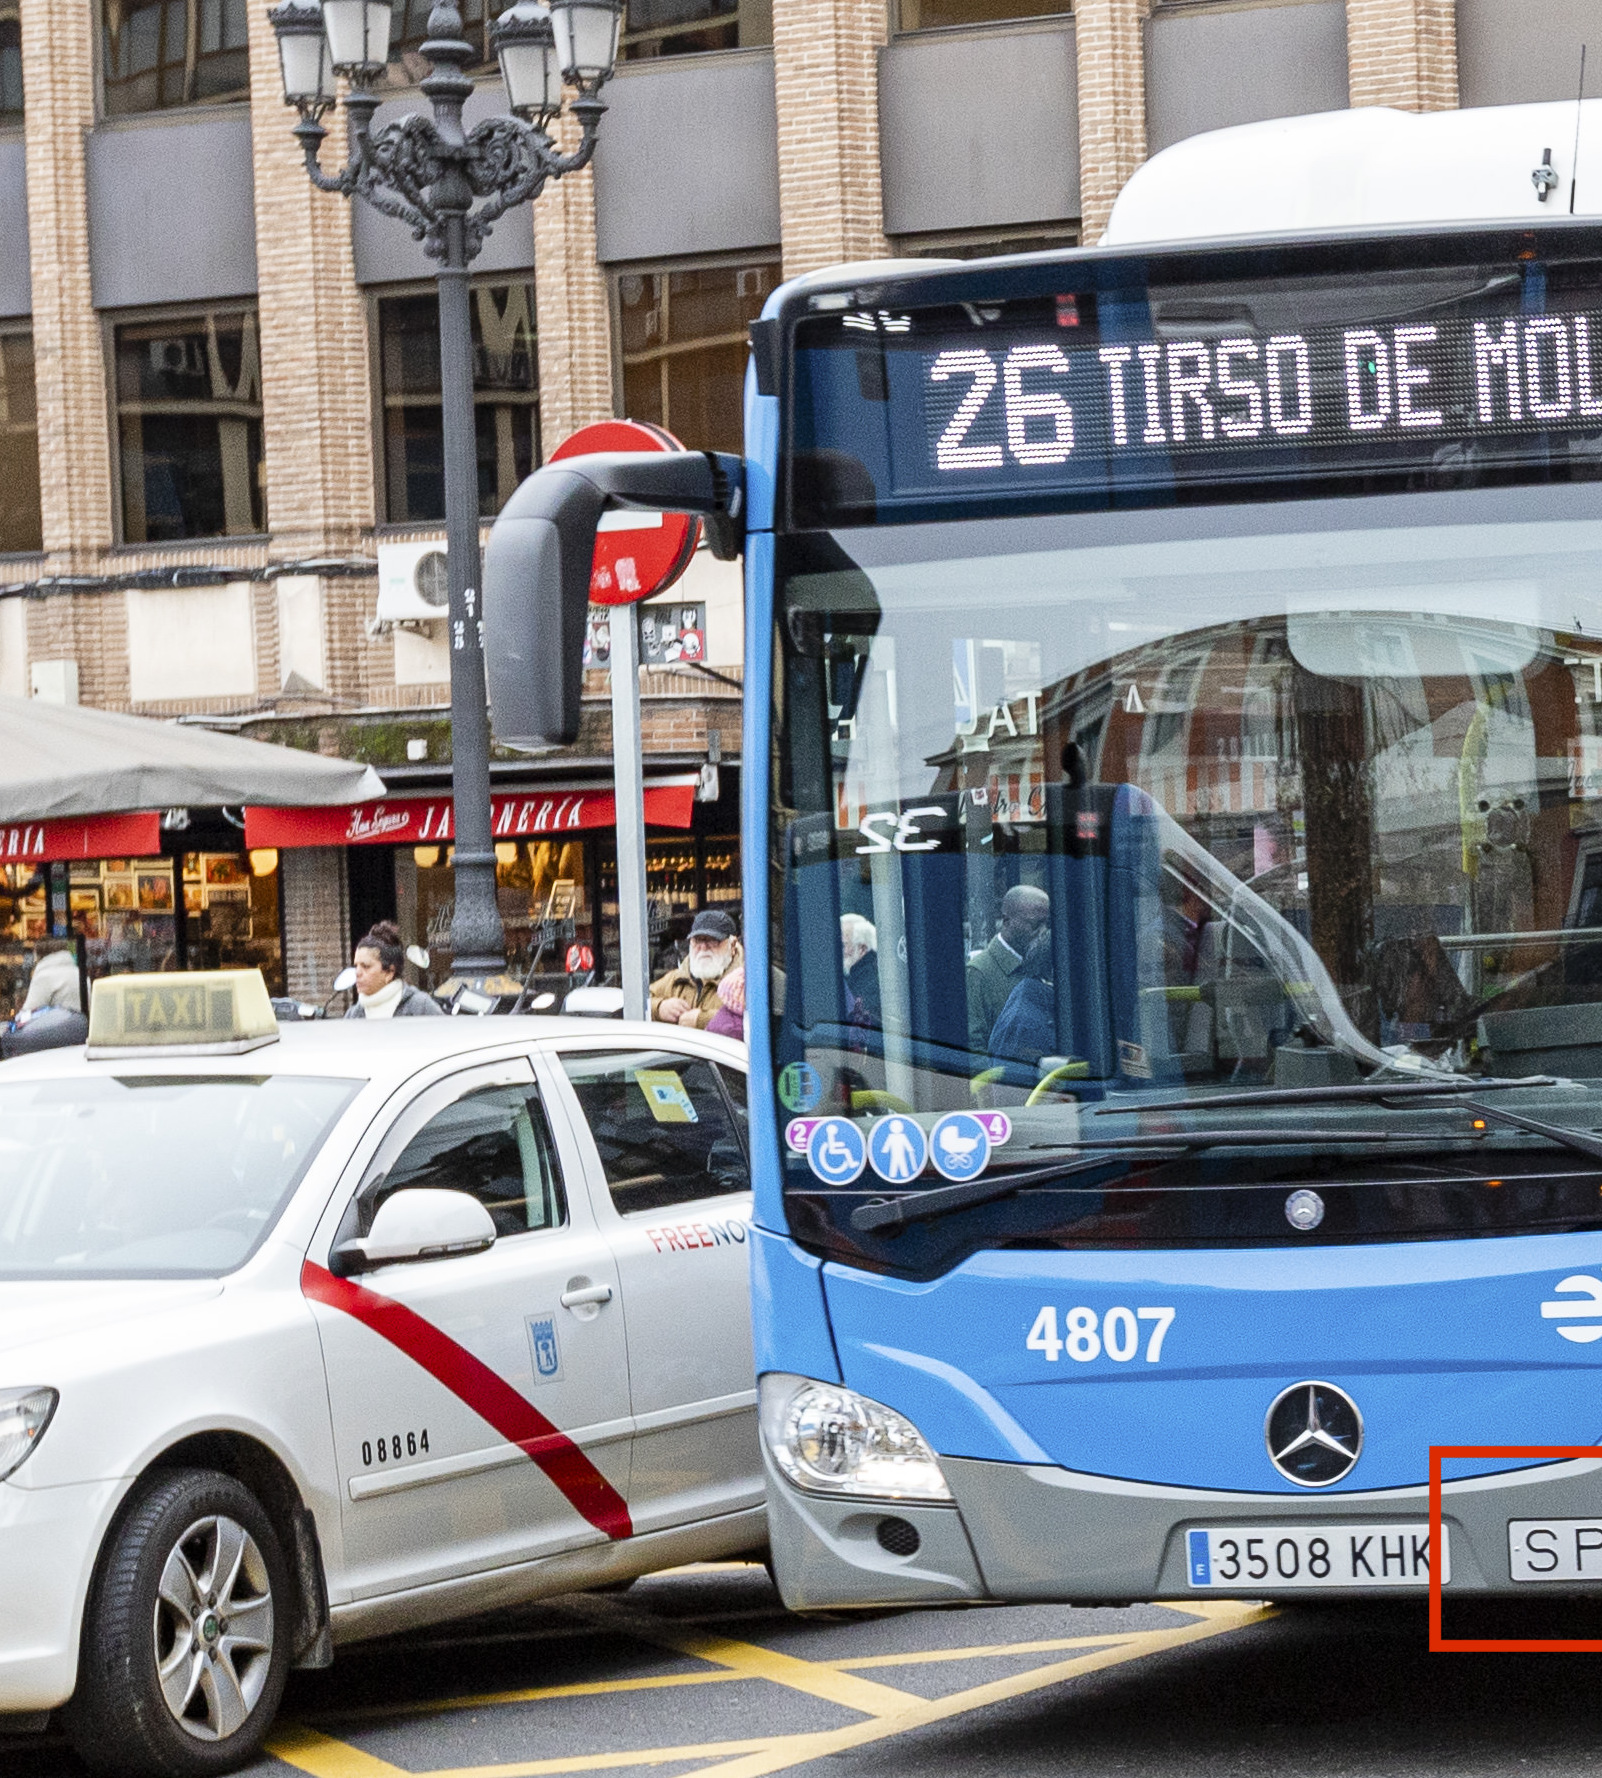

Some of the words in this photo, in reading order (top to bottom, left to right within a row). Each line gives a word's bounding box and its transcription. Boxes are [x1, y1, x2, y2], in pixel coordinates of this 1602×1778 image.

[931, 345, 1075, 470] 26
[1098, 334, 1312, 445] TIRSO
[1343, 326, 1443, 430] DE
[418, 796, 585, 839] JANERÍA
[126, 991, 203, 1027] TAXI
[792, 1123, 808, 1143] 2
[989, 1116, 1004, 1136] 4
[645, 1219, 746, 1254] FREENO
[1026, 1306, 1176, 1363] 4807
[361, 1427, 430, 1467] 08864
[1195, 1563, 1206, 1577] E
[1218, 1536, 1331, 1581] 3508
